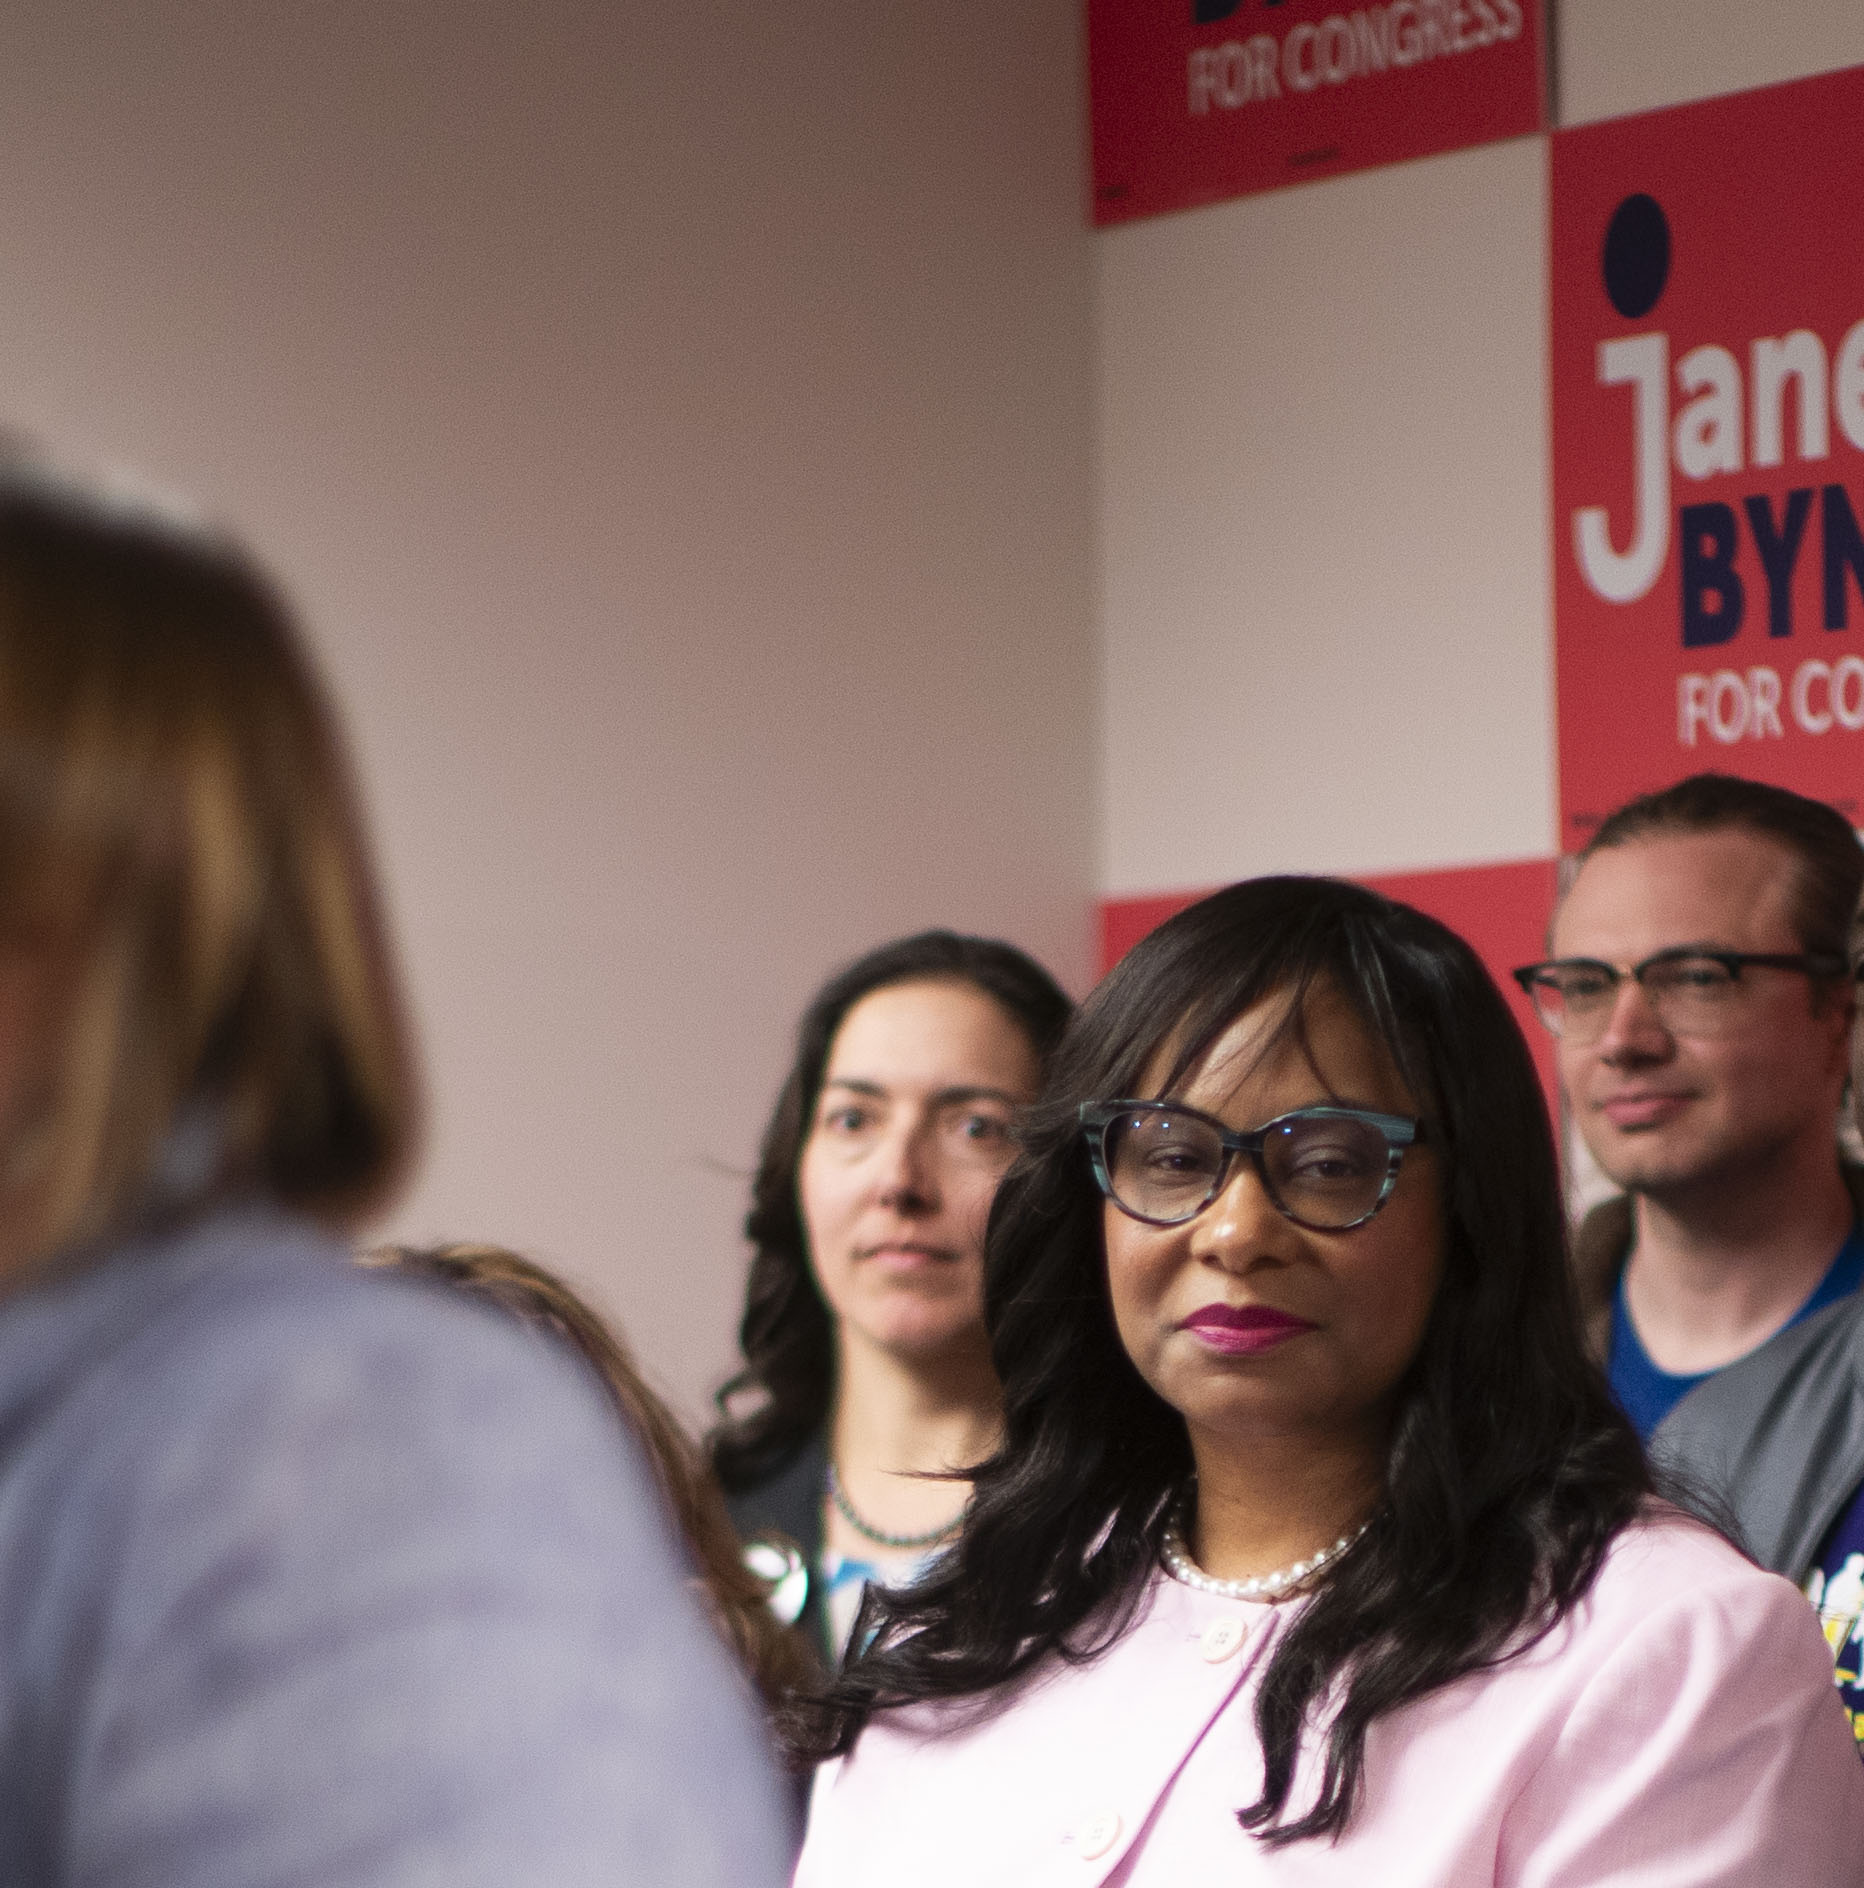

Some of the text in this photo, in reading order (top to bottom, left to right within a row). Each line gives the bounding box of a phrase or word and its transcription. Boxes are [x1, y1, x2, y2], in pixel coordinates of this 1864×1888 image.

[1188, 0, 1524, 116] FOR CONGRESS
[1677, 668, 1784, 747] FOR
